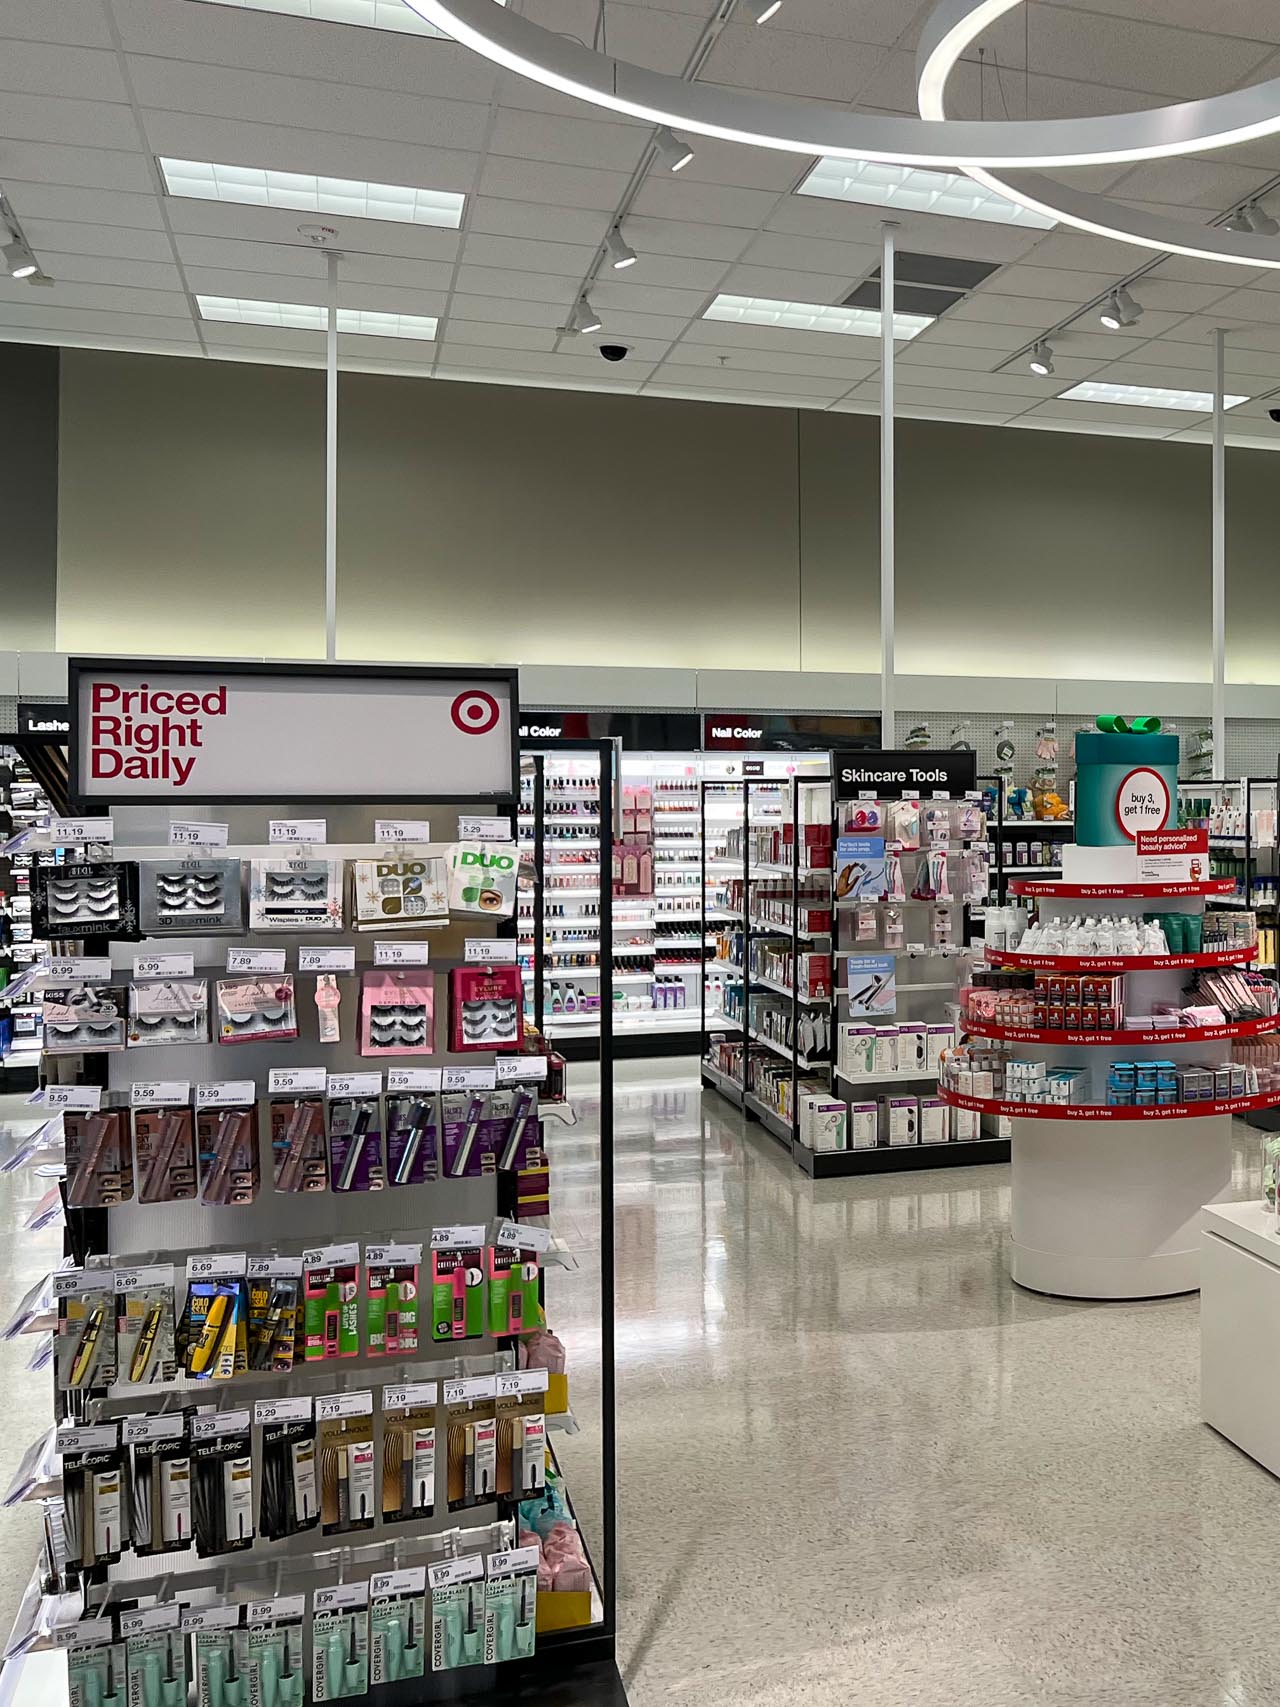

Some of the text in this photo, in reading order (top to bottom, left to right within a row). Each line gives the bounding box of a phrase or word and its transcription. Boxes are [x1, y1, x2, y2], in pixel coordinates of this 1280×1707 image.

[91, 683, 227, 715] Priced
[28, 720, 70, 731] Lashe
[91, 716, 203, 754] Right
[530, 726, 562, 737] Color
[712, 727, 762, 739] Nail Color
[91, 749, 196, 786] Daily
[842, 768, 948, 782] Skincare Tools
[1132, 793, 1155, 805] buy 3,
[1124, 805, 1160, 816] get 1 free
[56, 828, 84, 836] 11.19
[272, 828, 297, 836] 11.19
[463, 826, 481, 834] 5.29
[173, 832, 199, 841] 11.19
[1159, 835, 1198, 844] personalized
[461, 852, 514, 870] DUO
[377, 863, 426, 878] DUO
[158, 917, 173, 925] 3D
[58, 922, 110, 934] fauxmink
[468, 948, 490, 956] 11.19
[232, 957, 252, 965] 7.89
[302, 956, 321, 964] 7.89
[51, 966, 73, 975] 6.99
[138, 963, 159, 971] 6.99
[500, 1065, 518, 1073] 9.59
[273, 1078, 294, 1086] 9.59
[390, 1076, 409, 1085] 9.59
[447, 1076, 465, 1084] 9.59
[330, 1083, 350, 1092] 9.59
[49, 1094, 69, 1102] 9.59
[134, 1089, 155, 1098] 9.59
[199, 1090, 219, 1098] 9.59
[500, 1231, 516, 1240] 4.89
[305, 1256, 322, 1264] 4.89
[192, 1264, 212, 1272] 6.69
[250, 1264, 270, 1272] 7.89
[56, 1281, 77, 1290] 6.69
[116, 1278, 137, 1288] 6.69
[501, 1382, 519, 1390] 7.19
[446, 1388, 464, 1398] 7.19
[387, 1394, 406, 1403] 7.19
[256, 1408, 276, 1418] 9.29
[321, 1405, 340, 1413] 7.19
[128, 1427, 148, 1436] 9.29
[195, 1423, 216, 1432] 9.29
[58, 1438, 79, 1447] 9.29
[136, 1442, 181, 1455] TELECOPIC
[64, 1455, 111, 1469] TELECOPIC
[252, 1607, 272, 1616] 8.99
[123, 1620, 143, 1629] 8.99
[183, 1617, 204, 1627] 8.99
[486, 1613, 495, 1661] COVERGIRL
[434, 1619, 442, 1668] COVERGIRL
[374, 1634, 382, 1682] COVERGIRL
[316, 1650, 324, 1699] COVERGIRL
[131, 1670, 140, 1707] VERGIRL
[250, 1663, 258, 1707] OVERGIRL
